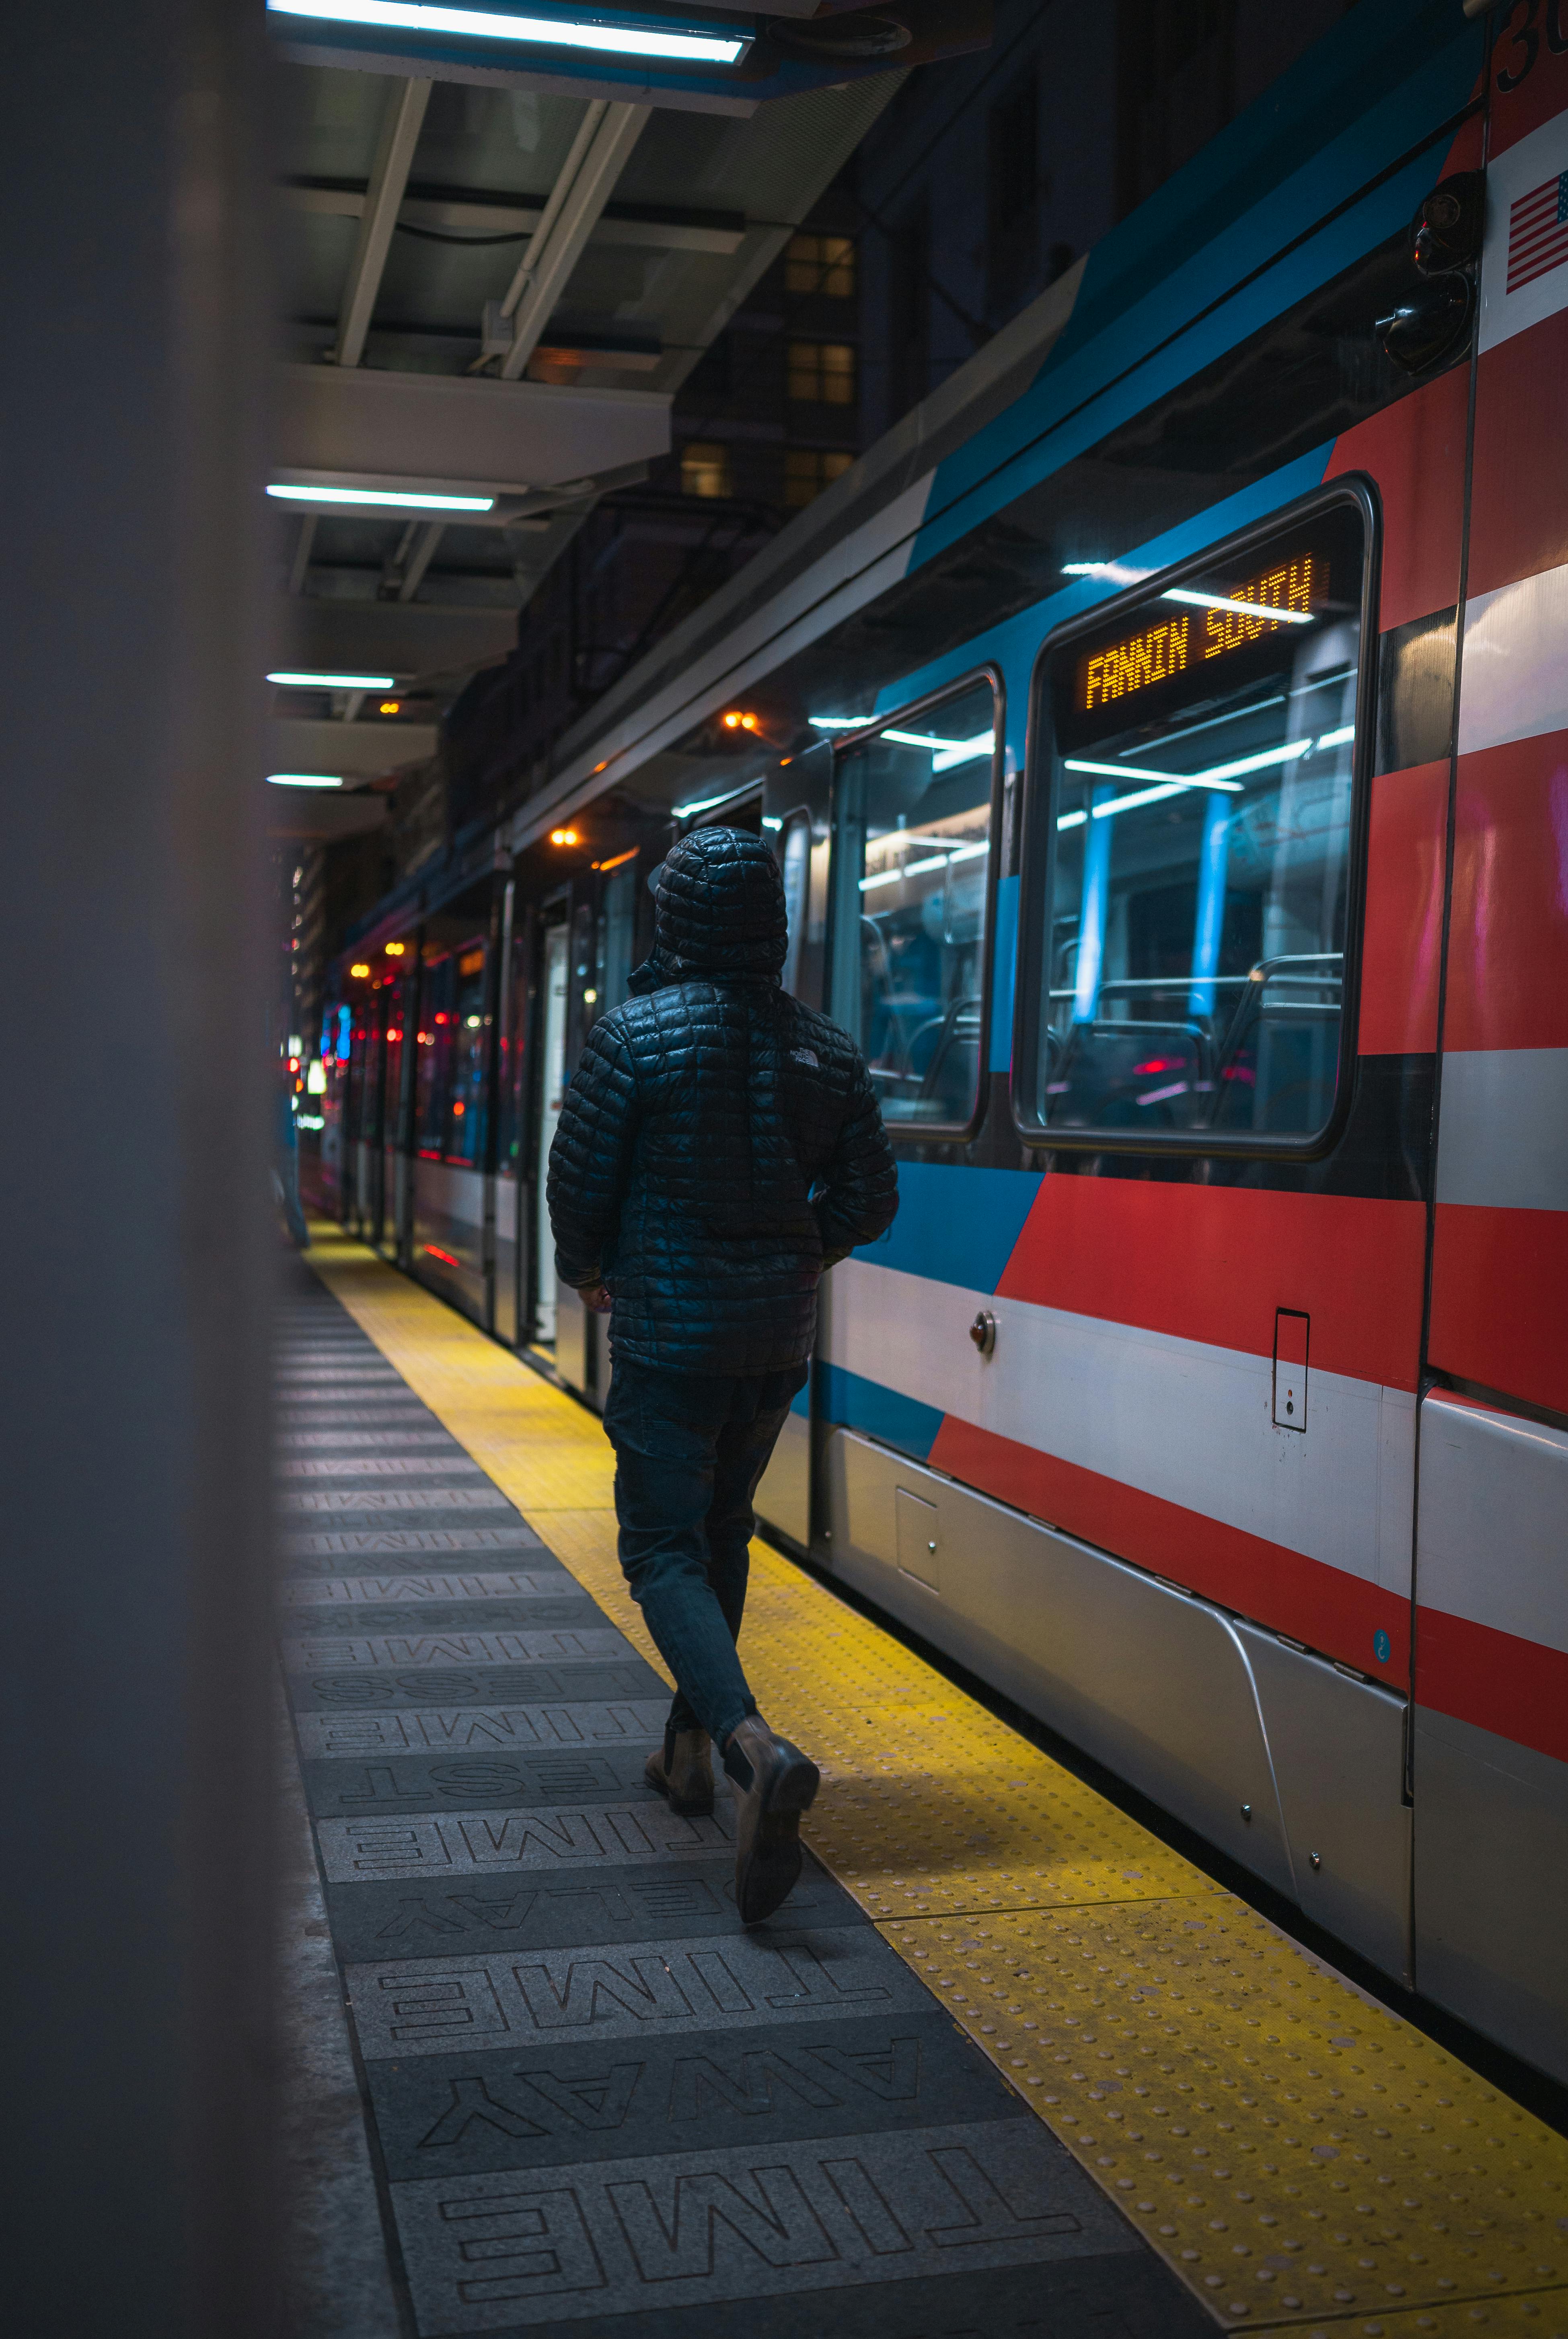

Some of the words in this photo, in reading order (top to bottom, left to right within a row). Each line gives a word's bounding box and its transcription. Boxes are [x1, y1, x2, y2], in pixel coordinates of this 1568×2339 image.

[1497, 0, 1568, 93] 3
[1087, 616, 1189, 709] FANNIN
[1205, 558, 1311, 659] SOUTH
[790, 1050, 809, 1059] NORTH
[795, 1056, 810, 1065] FACE
[288, 1575, 565, 1601] TIME
[302, 1633, 618, 1667] TIME
[312, 1668, 651, 1702] LESS
[321, 1708, 665, 1750] TIME
[339, 1756, 720, 1804] EST
[347, 1811, 737, 1870] TIME
[378, 1945, 892, 2041] TIME
[419, 2037, 923, 2148] AWAY
[438, 2146, 1082, 2304] TIME
